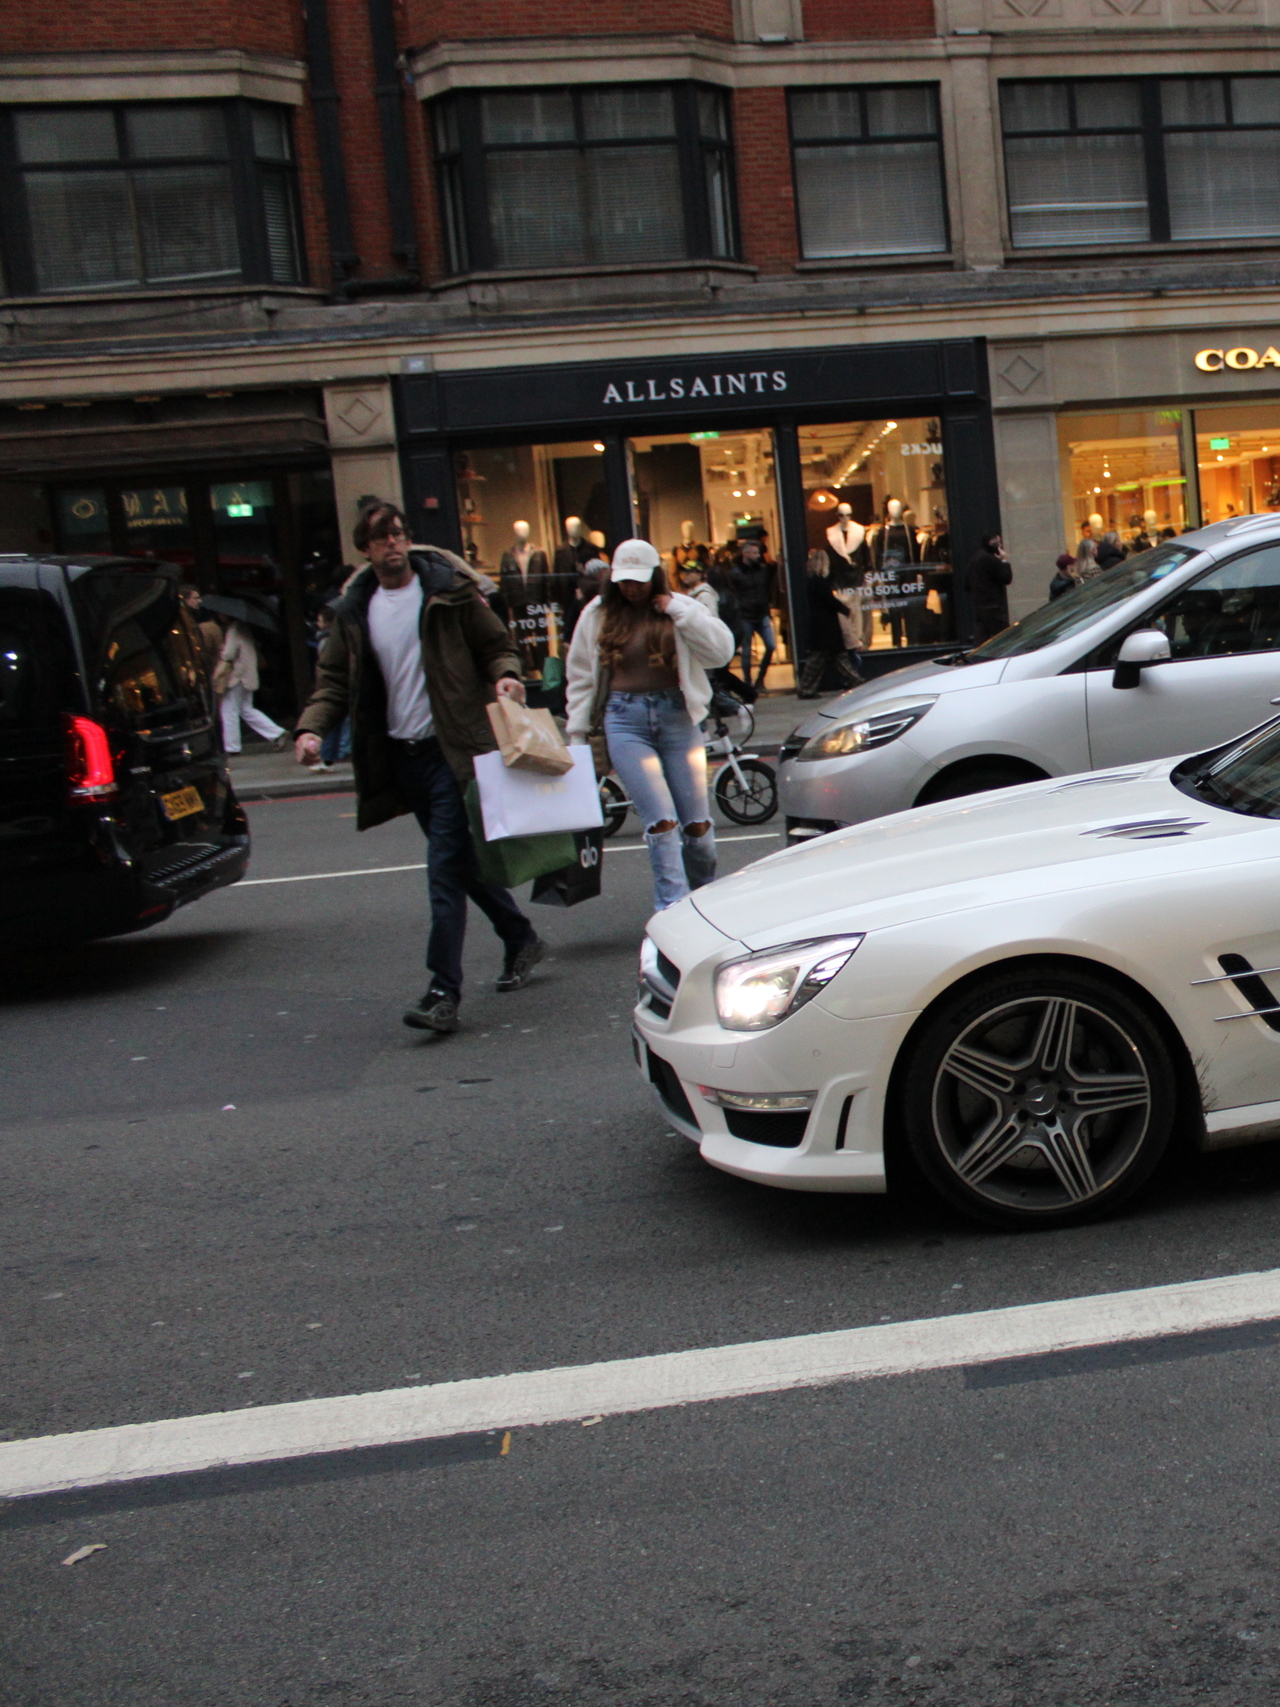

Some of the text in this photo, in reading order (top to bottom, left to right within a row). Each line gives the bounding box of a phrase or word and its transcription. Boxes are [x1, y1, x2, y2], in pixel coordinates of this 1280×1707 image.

[602, 371, 787, 404] ALLSAINTS
[864, 571, 896, 583] SALE
[856, 586, 873, 596] TO
[875, 584, 900, 595] 50%
[901, 583, 924, 594] OFF
[526, 602, 560, 615] SALE
[518, 618, 536, 629] TO
